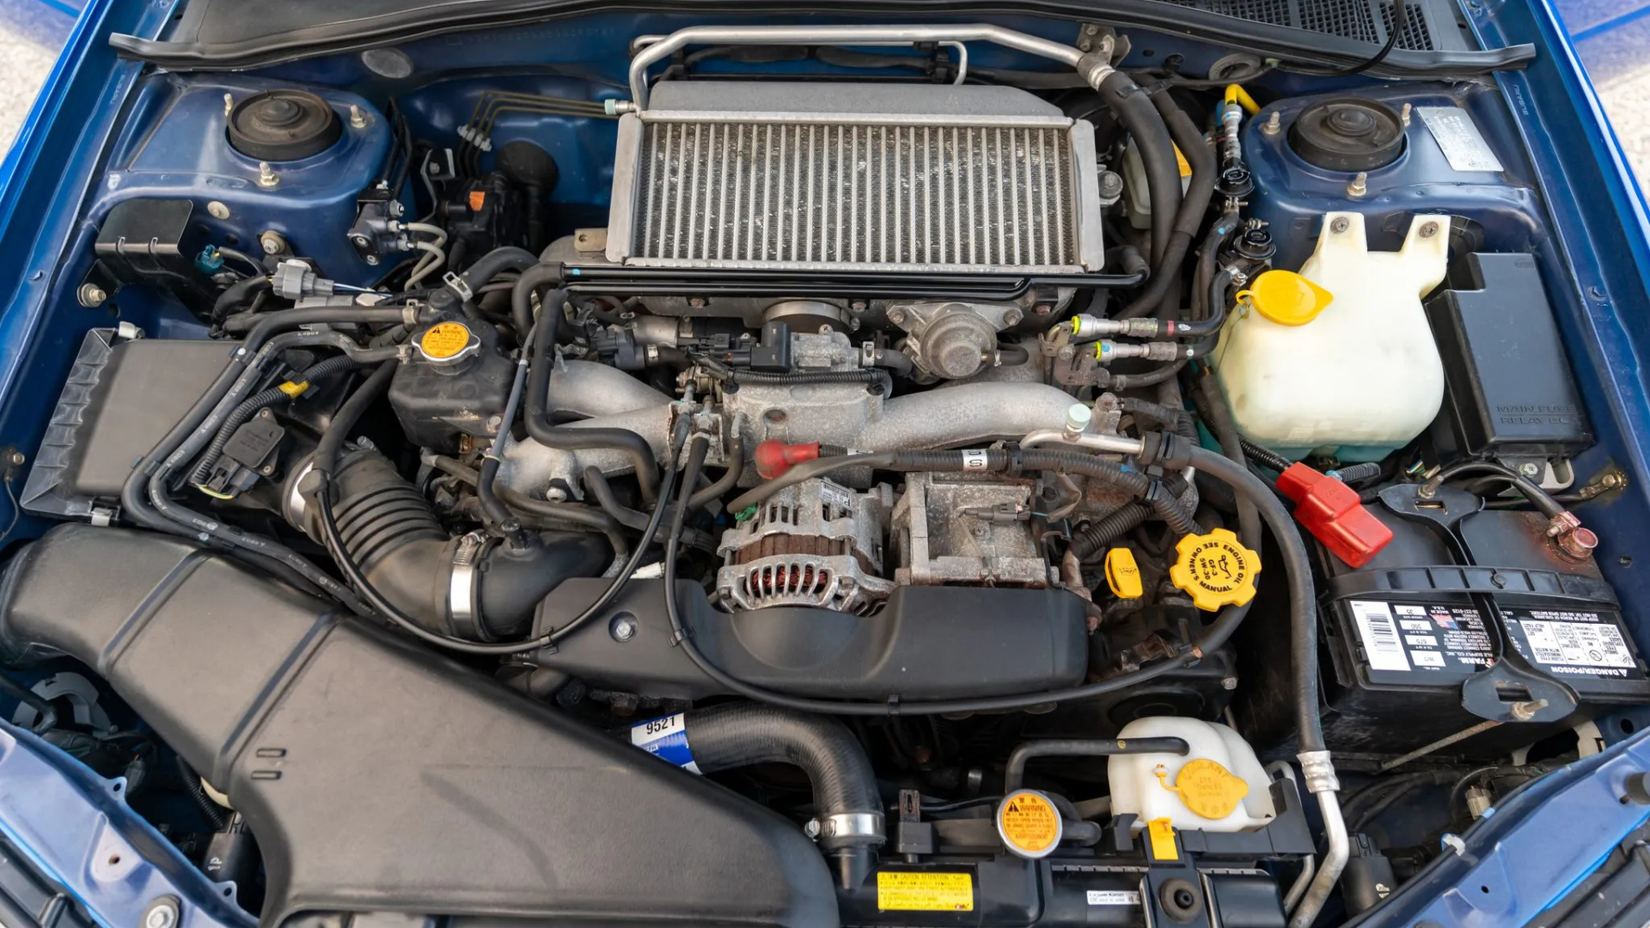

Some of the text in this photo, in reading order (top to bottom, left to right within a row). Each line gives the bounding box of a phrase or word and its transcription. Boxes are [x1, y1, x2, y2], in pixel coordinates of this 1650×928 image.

[1223, 544, 1245, 584] ENGINE OIL
[1199, 581, 1232, 592] MANUAL
[1551, 666, 1620, 676] DANGER/POISON
[646, 716, 675, 735] 9521
